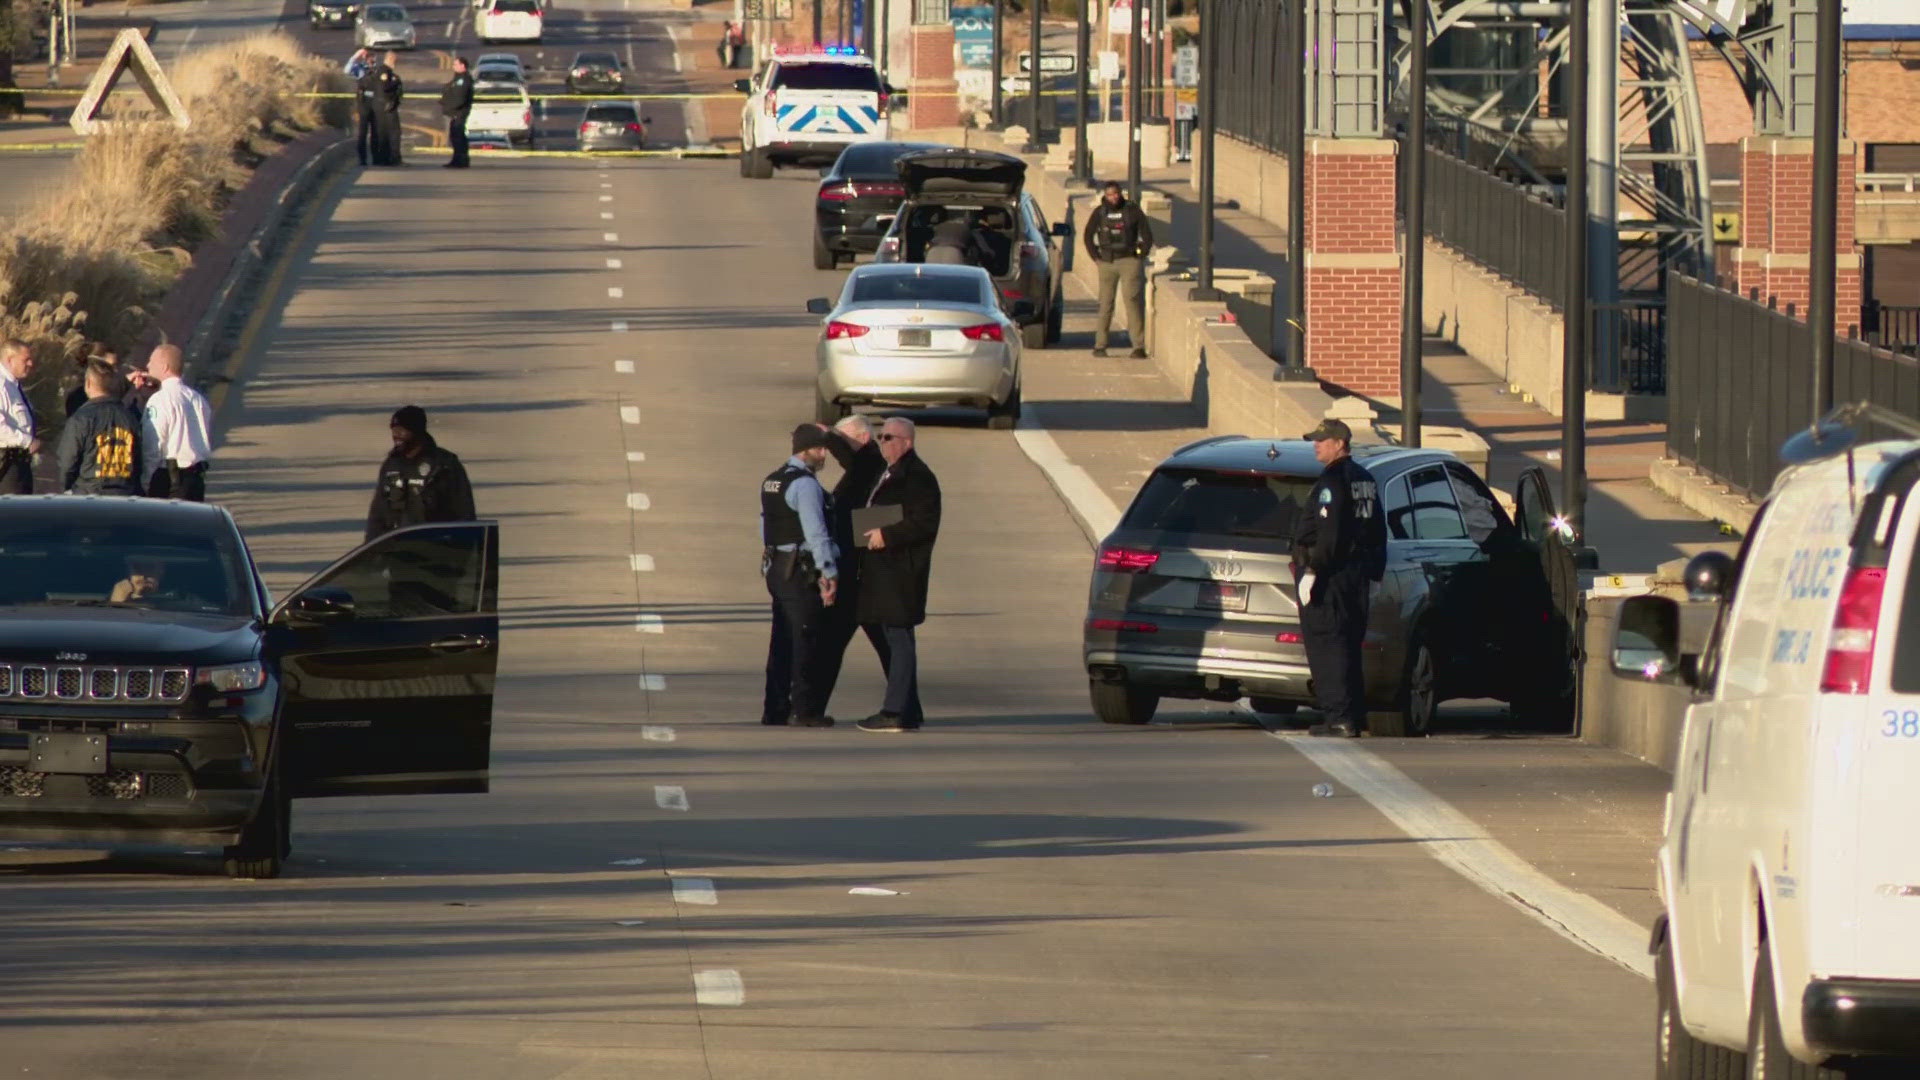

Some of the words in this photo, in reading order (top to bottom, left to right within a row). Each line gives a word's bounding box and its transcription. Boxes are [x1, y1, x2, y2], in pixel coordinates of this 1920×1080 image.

[1613, 576, 1620, 586] C
[56, 651, 88, 661] Jeep
[1880, 709, 1920, 738] 38
